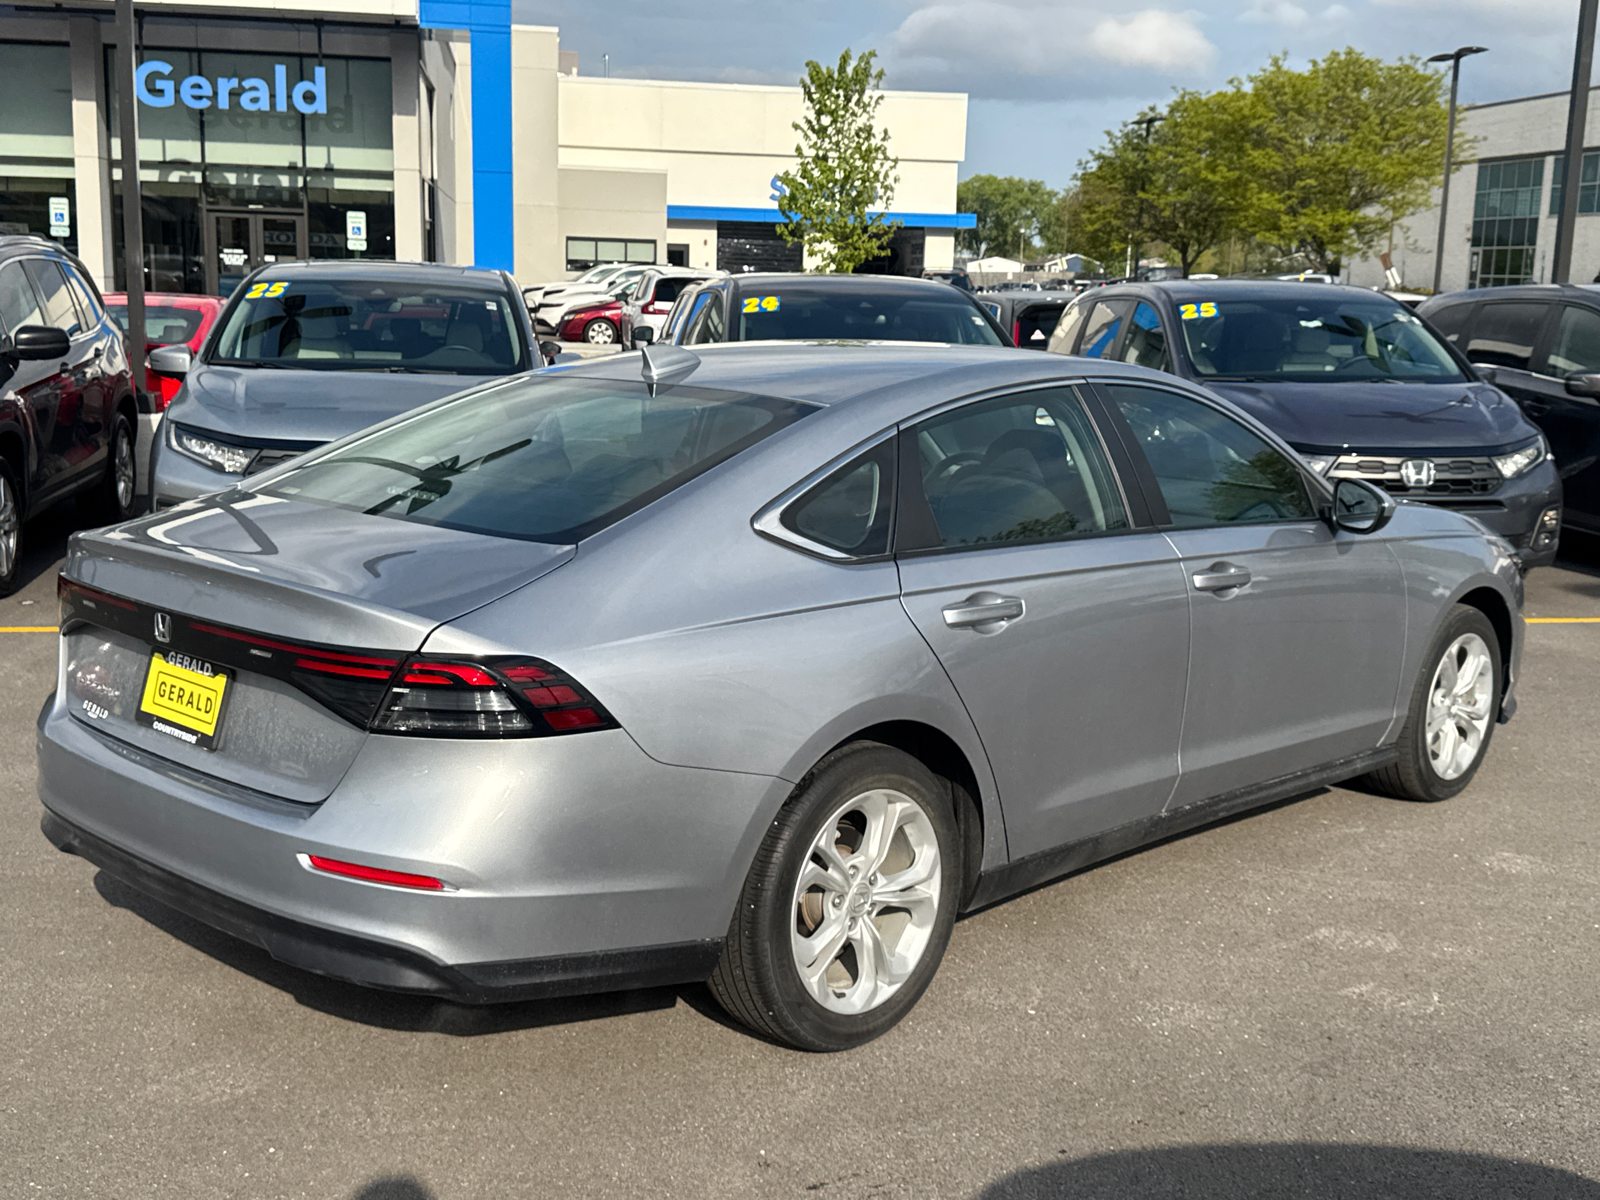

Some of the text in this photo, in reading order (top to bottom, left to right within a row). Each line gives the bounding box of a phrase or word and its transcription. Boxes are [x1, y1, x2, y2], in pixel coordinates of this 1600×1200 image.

[136, 60, 327, 114] Gerald
[264, 231, 338, 245] HODA
[245, 281, 289, 298] 25
[742, 296, 779, 313] 24
[1180, 302, 1217, 319] 25
[168, 651, 212, 676] GERALD
[158, 680, 213, 715] GERALD
[82, 700, 109, 719] GERALD
[153, 721, 197, 744] COUNTRYSIDE
